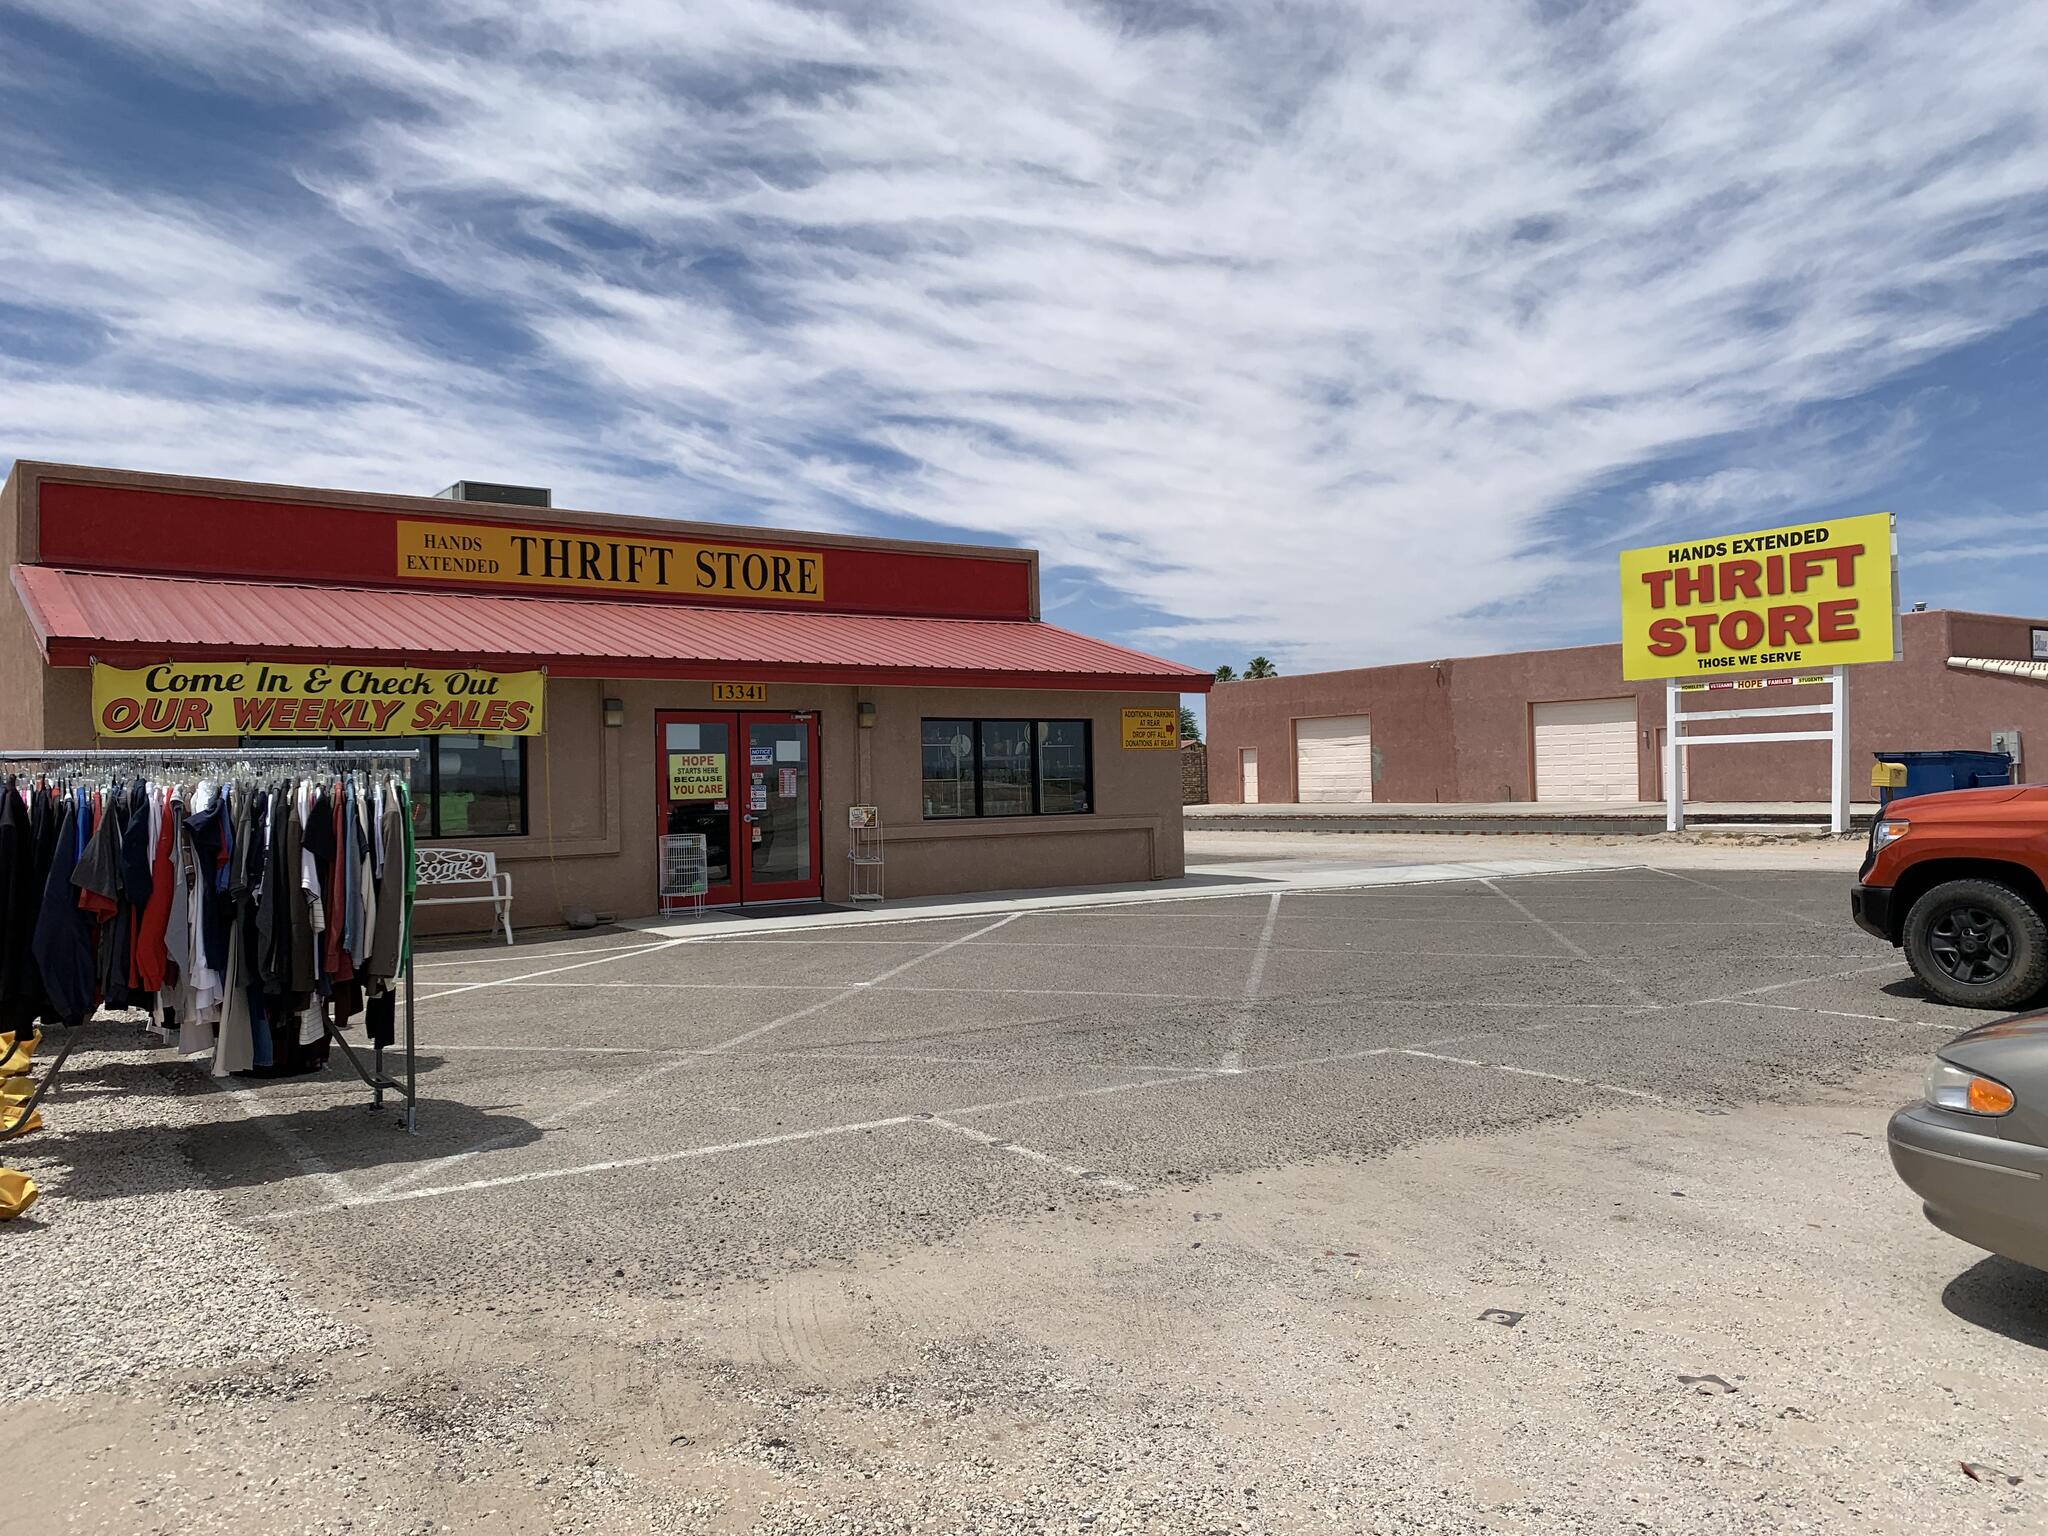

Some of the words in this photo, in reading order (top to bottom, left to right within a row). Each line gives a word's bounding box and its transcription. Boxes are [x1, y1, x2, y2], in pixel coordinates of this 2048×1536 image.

[423, 533, 482, 551] HANDS
[1668, 542, 1728, 563] HANDS
[1732, 528, 1830, 555] EXTENDED
[406, 554, 499, 574] EXTENDED
[510, 535, 674, 586] THRIFT
[696, 550, 818, 595] STORE
[1641, 543, 1866, 610] THRIFT
[1647, 598, 1861, 657] STORE
[1698, 657, 1736, 669] THOSE
[1739, 654, 1757, 665] WE
[1760, 651, 1802, 663] SERVE
[145, 666, 246, 693] Come
[256, 666, 293, 693] In
[303, 668, 332, 693] &
[340, 669, 435, 695] Check
[444, 672, 500, 696] Out
[1738, 680, 1762, 688] HOPE
[716, 685, 763, 699] 13341
[102, 697, 213, 733] OUR
[233, 697, 405, 732] WEEKLY
[410, 699, 534, 732] SALES
[682, 756, 714, 766] HOPE
[674, 785, 695, 795] YOU
[698, 784, 723, 794] CARE
[415, 861, 472, 876] come
